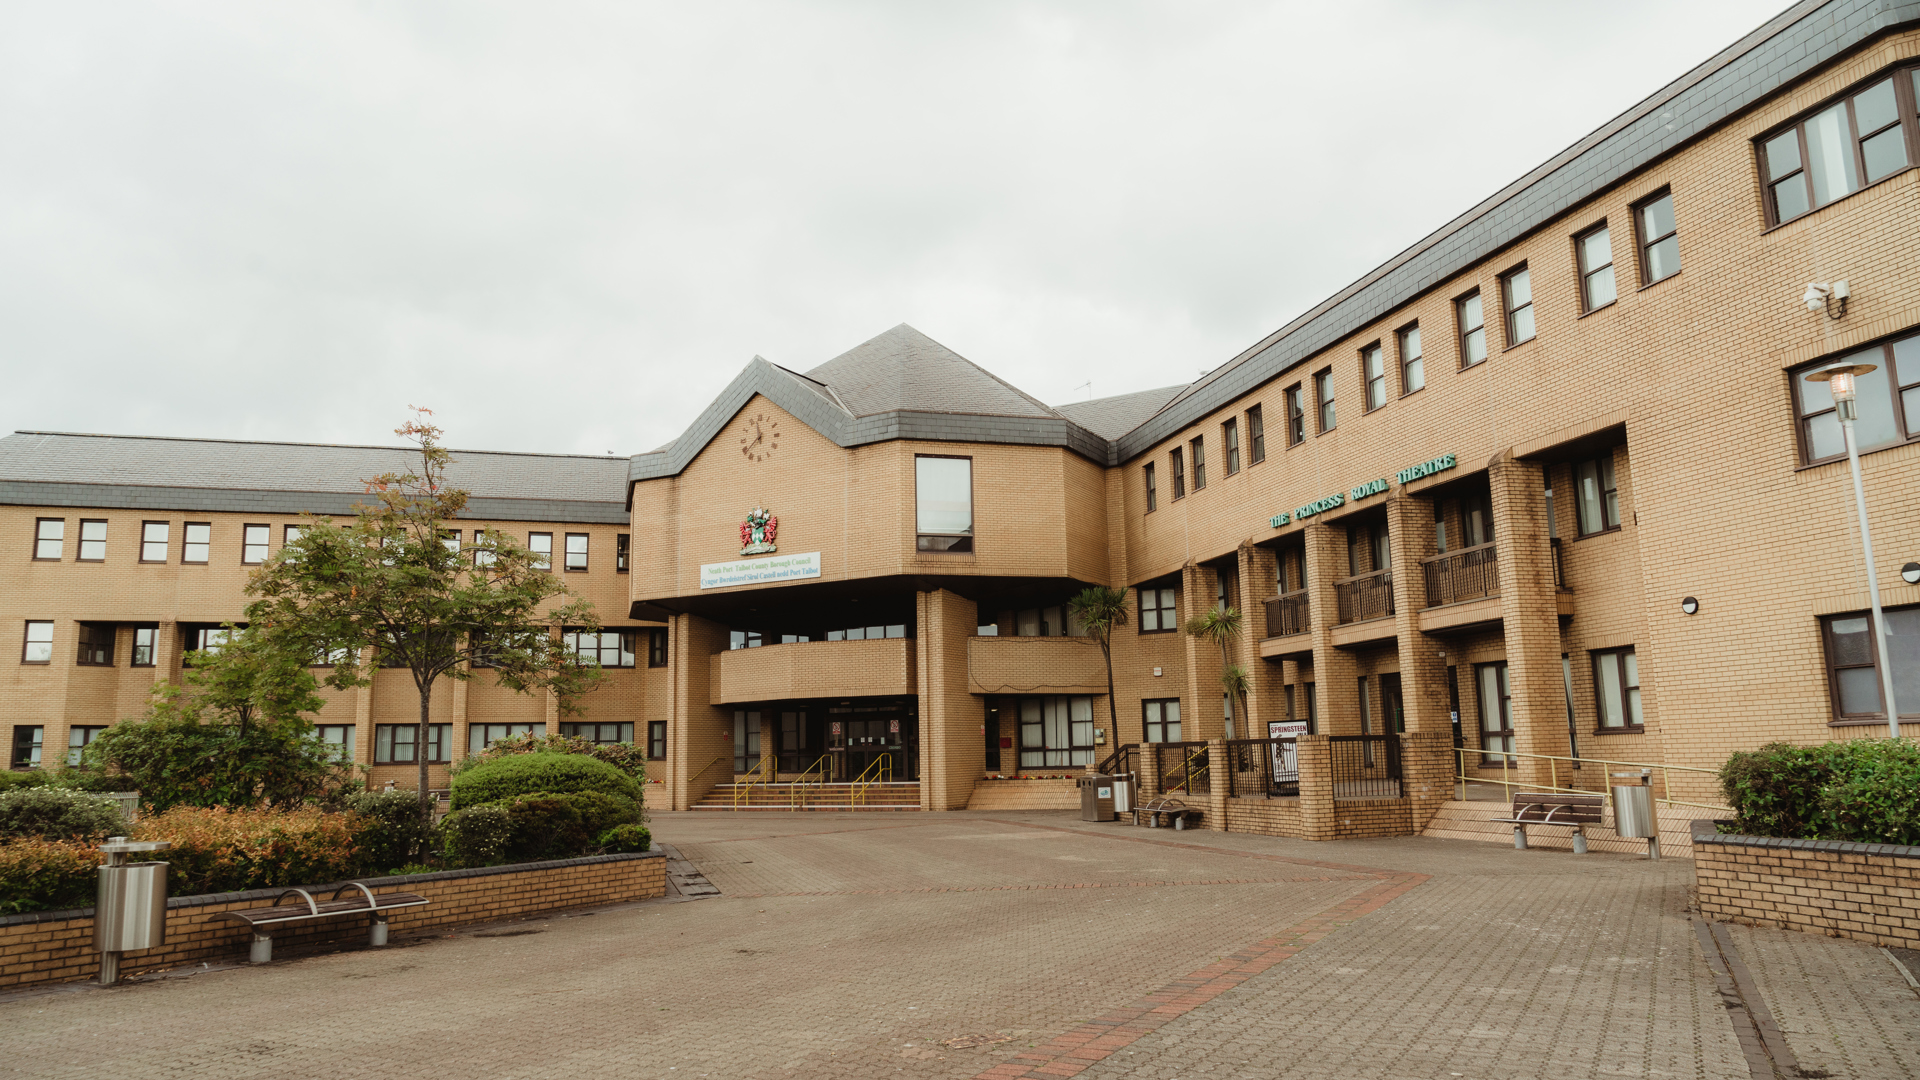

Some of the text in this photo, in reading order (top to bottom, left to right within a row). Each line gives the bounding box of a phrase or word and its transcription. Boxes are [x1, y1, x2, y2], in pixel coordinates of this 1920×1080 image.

[1270, 453, 1457, 529] THE PRINCESS ROYAL THEATRE
[735, 563, 751, 571] Talbot
[751, 561, 769, 570] County
[770, 559, 791, 568] Borough
[792, 557, 811, 565] Council
[790, 568, 801, 576] Port
[802, 567, 818, 575] Talbot
[1270, 725, 1306, 734] SPRINGSTEEN
